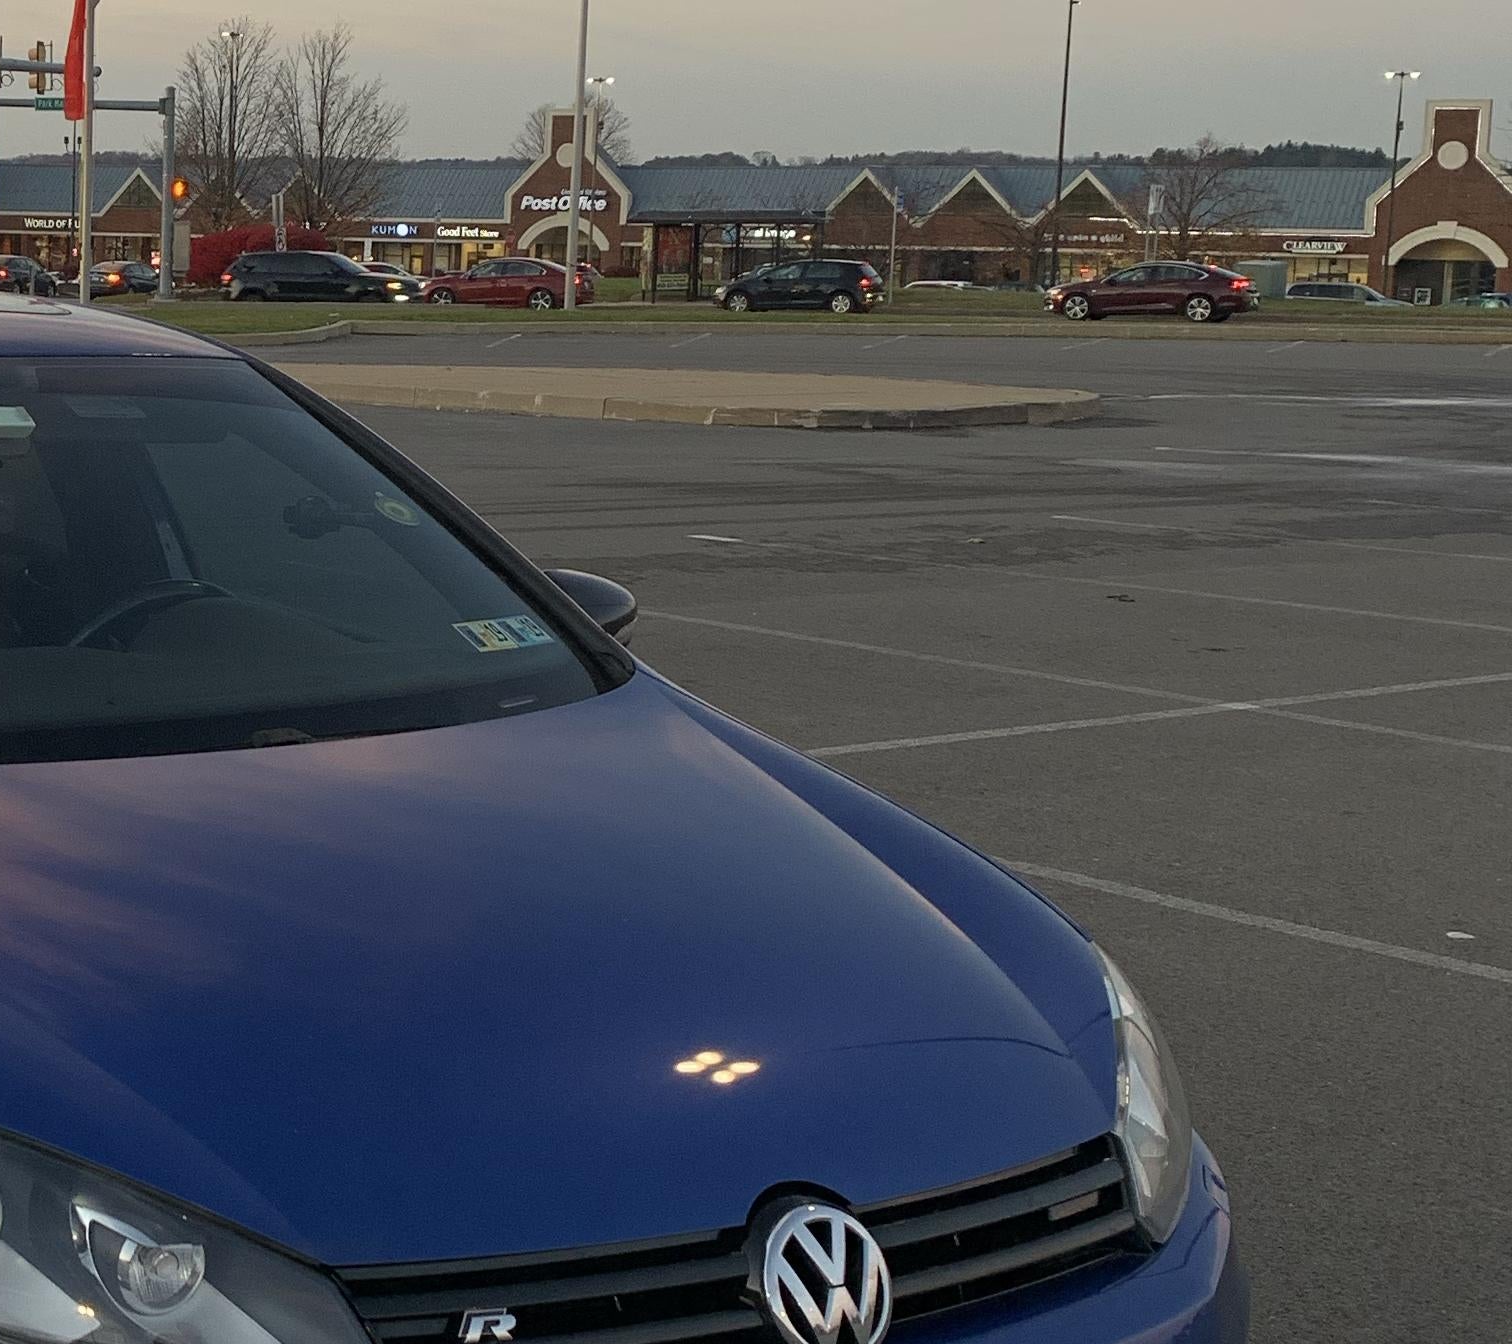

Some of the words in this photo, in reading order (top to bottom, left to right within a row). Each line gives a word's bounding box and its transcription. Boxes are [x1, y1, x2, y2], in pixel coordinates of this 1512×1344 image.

[520, 196, 558, 211] Post
[557, 196, 607, 211] Ofice
[23, 218, 55, 228] WORLD
[55, 219, 67, 229] OF
[372, 223, 418, 237] KUMON
[437, 226, 460, 237] Good
[461, 226, 479, 237] Feet
[479, 229, 499, 238] Store
[458, 1307, 517, 1344] R
